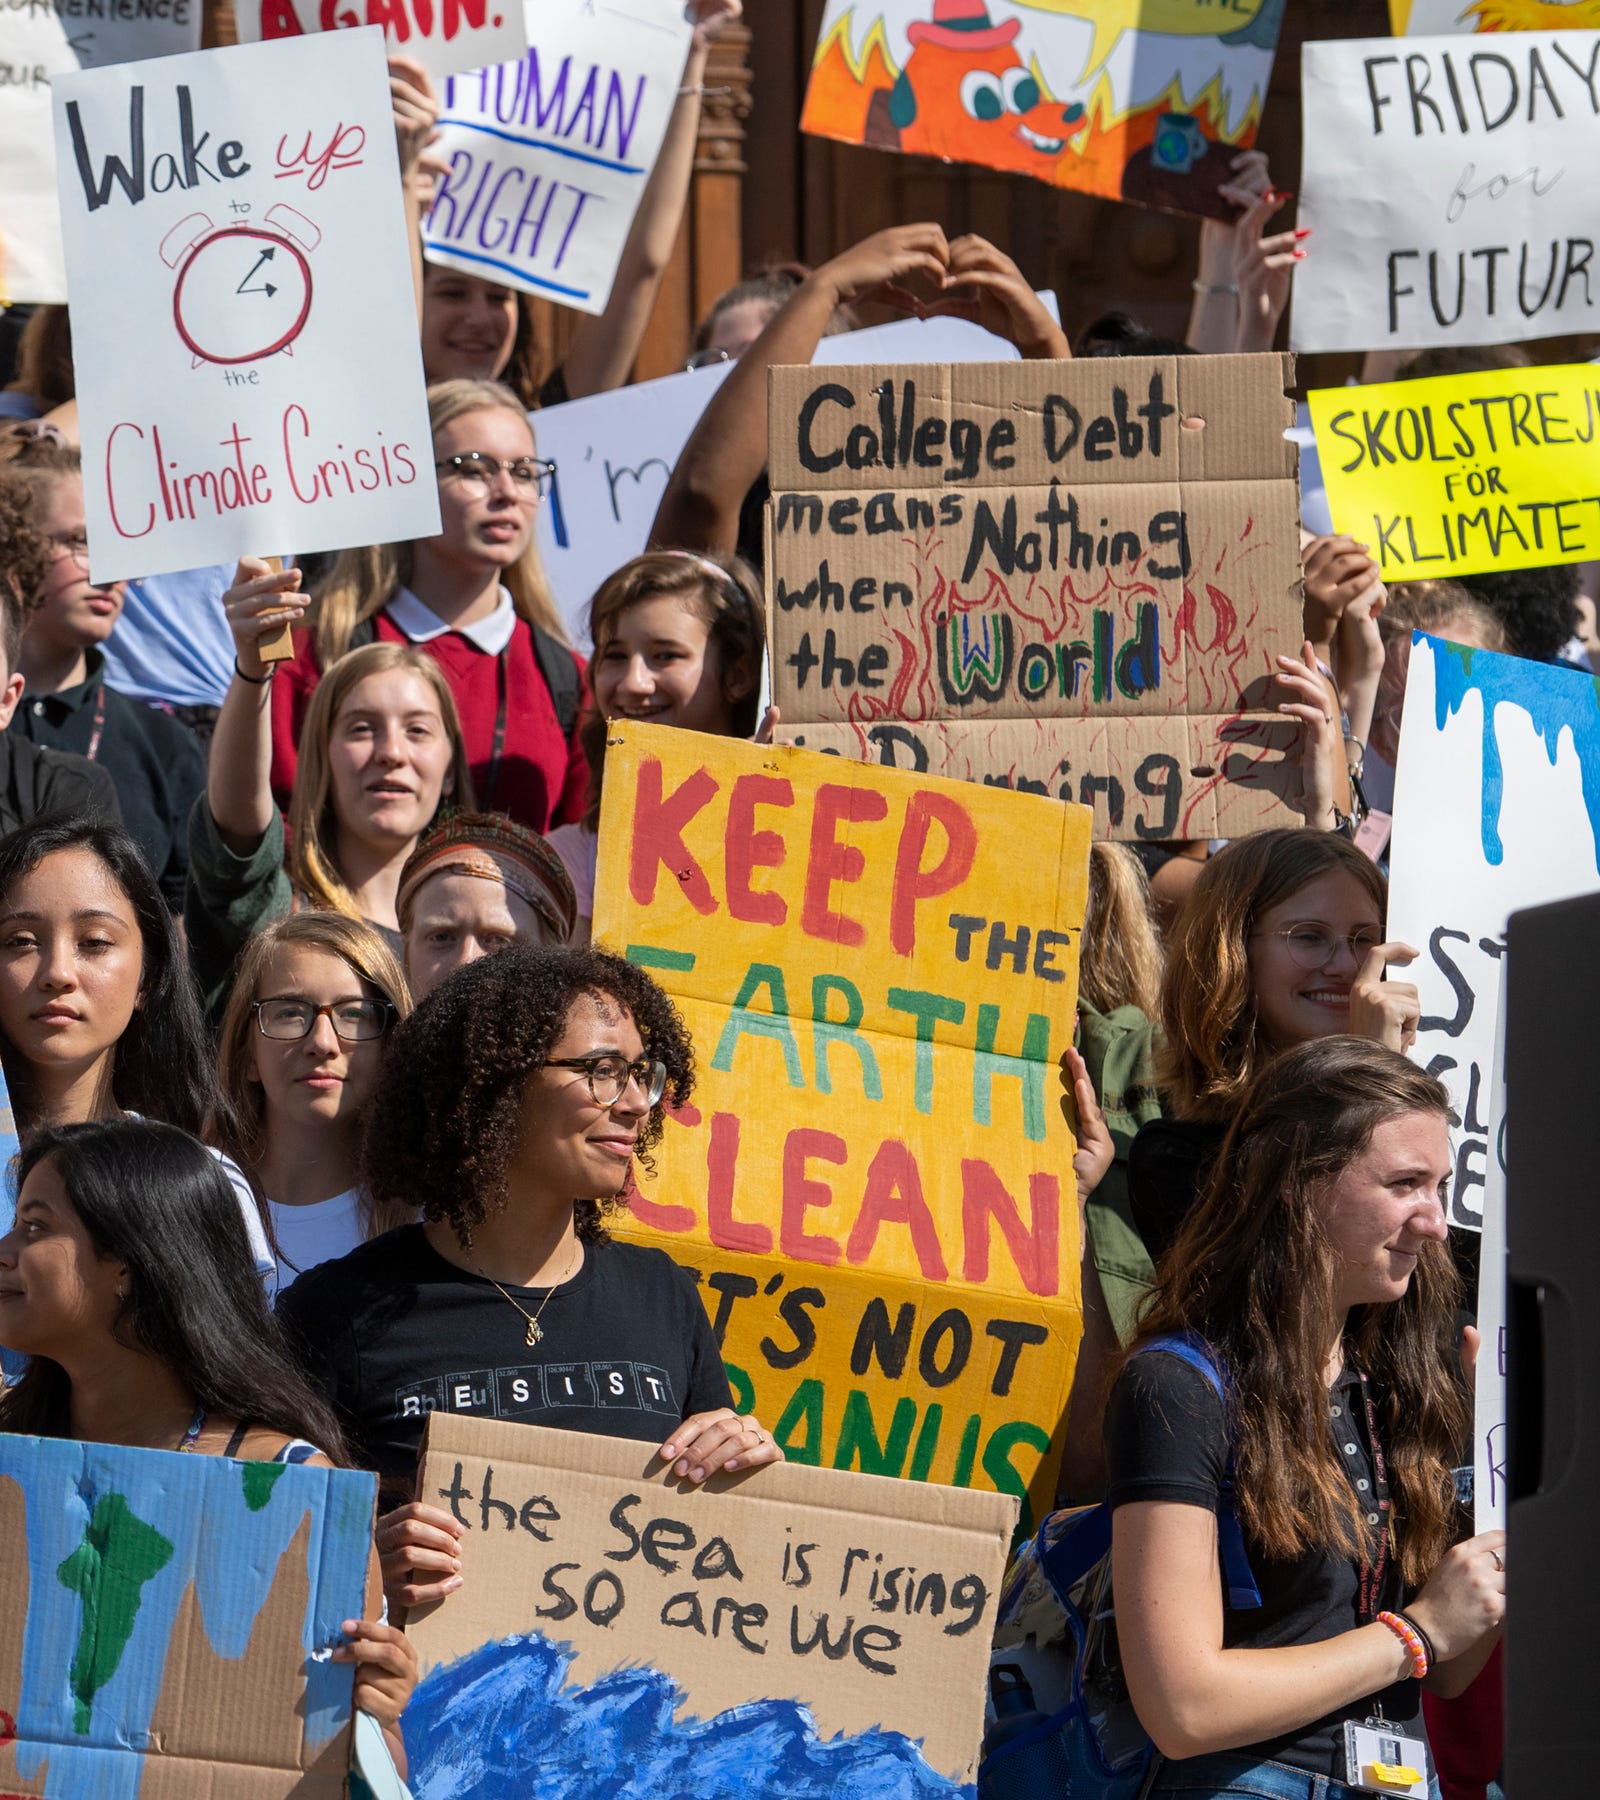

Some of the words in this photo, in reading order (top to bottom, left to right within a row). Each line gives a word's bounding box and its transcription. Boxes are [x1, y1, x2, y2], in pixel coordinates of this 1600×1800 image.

[65, 84, 252, 213] Wake
[276, 121, 367, 191] up
[446, 46, 647, 161] HUMAN
[228, 199, 252, 214] to
[426, 149, 608, 271] RIGHT
[1446, 161, 1565, 224] for
[223, 369, 261, 387] the
[796, 378, 1017, 481] College
[1043, 370, 1176, 465] Debt
[104, 422, 273, 540] Climate
[282, 403, 418, 505] Crisis
[1330, 388, 1600, 474] SKOLSTREJ
[1443, 462, 1509, 502] FÖR
[776, 490, 965, 536] means
[961, 476, 1192, 583] Nothing
[776, 559, 914, 614] when
[789, 631, 889, 691] the
[936, 601, 1161, 705] World
[628, 757, 980, 958] KEEP
[948, 913, 1072, 984] THE
[624, 1090, 1060, 1297] CLEAN
[849, 1297, 1050, 1397] NOT
[438, 1461, 562, 1543] the
[782, 1526, 820, 1589] is
[839, 1546, 993, 1638] rising
[660, 1590, 770, 1656] are
